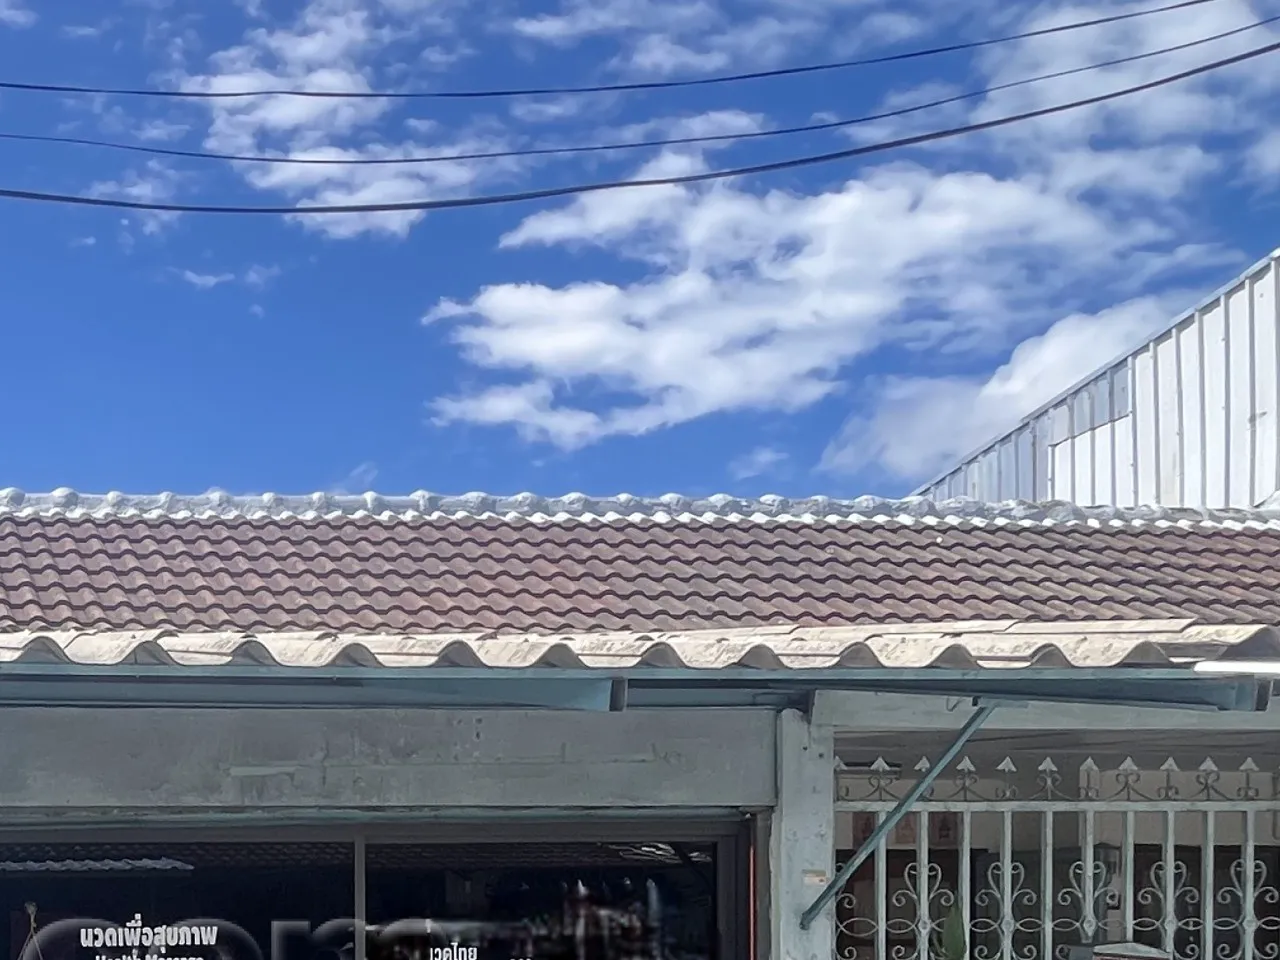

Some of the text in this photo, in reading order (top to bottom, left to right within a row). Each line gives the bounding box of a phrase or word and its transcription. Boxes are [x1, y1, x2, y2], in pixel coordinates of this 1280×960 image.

[80, 913, 218, 953] นวดเพื่อสุขภาพ
